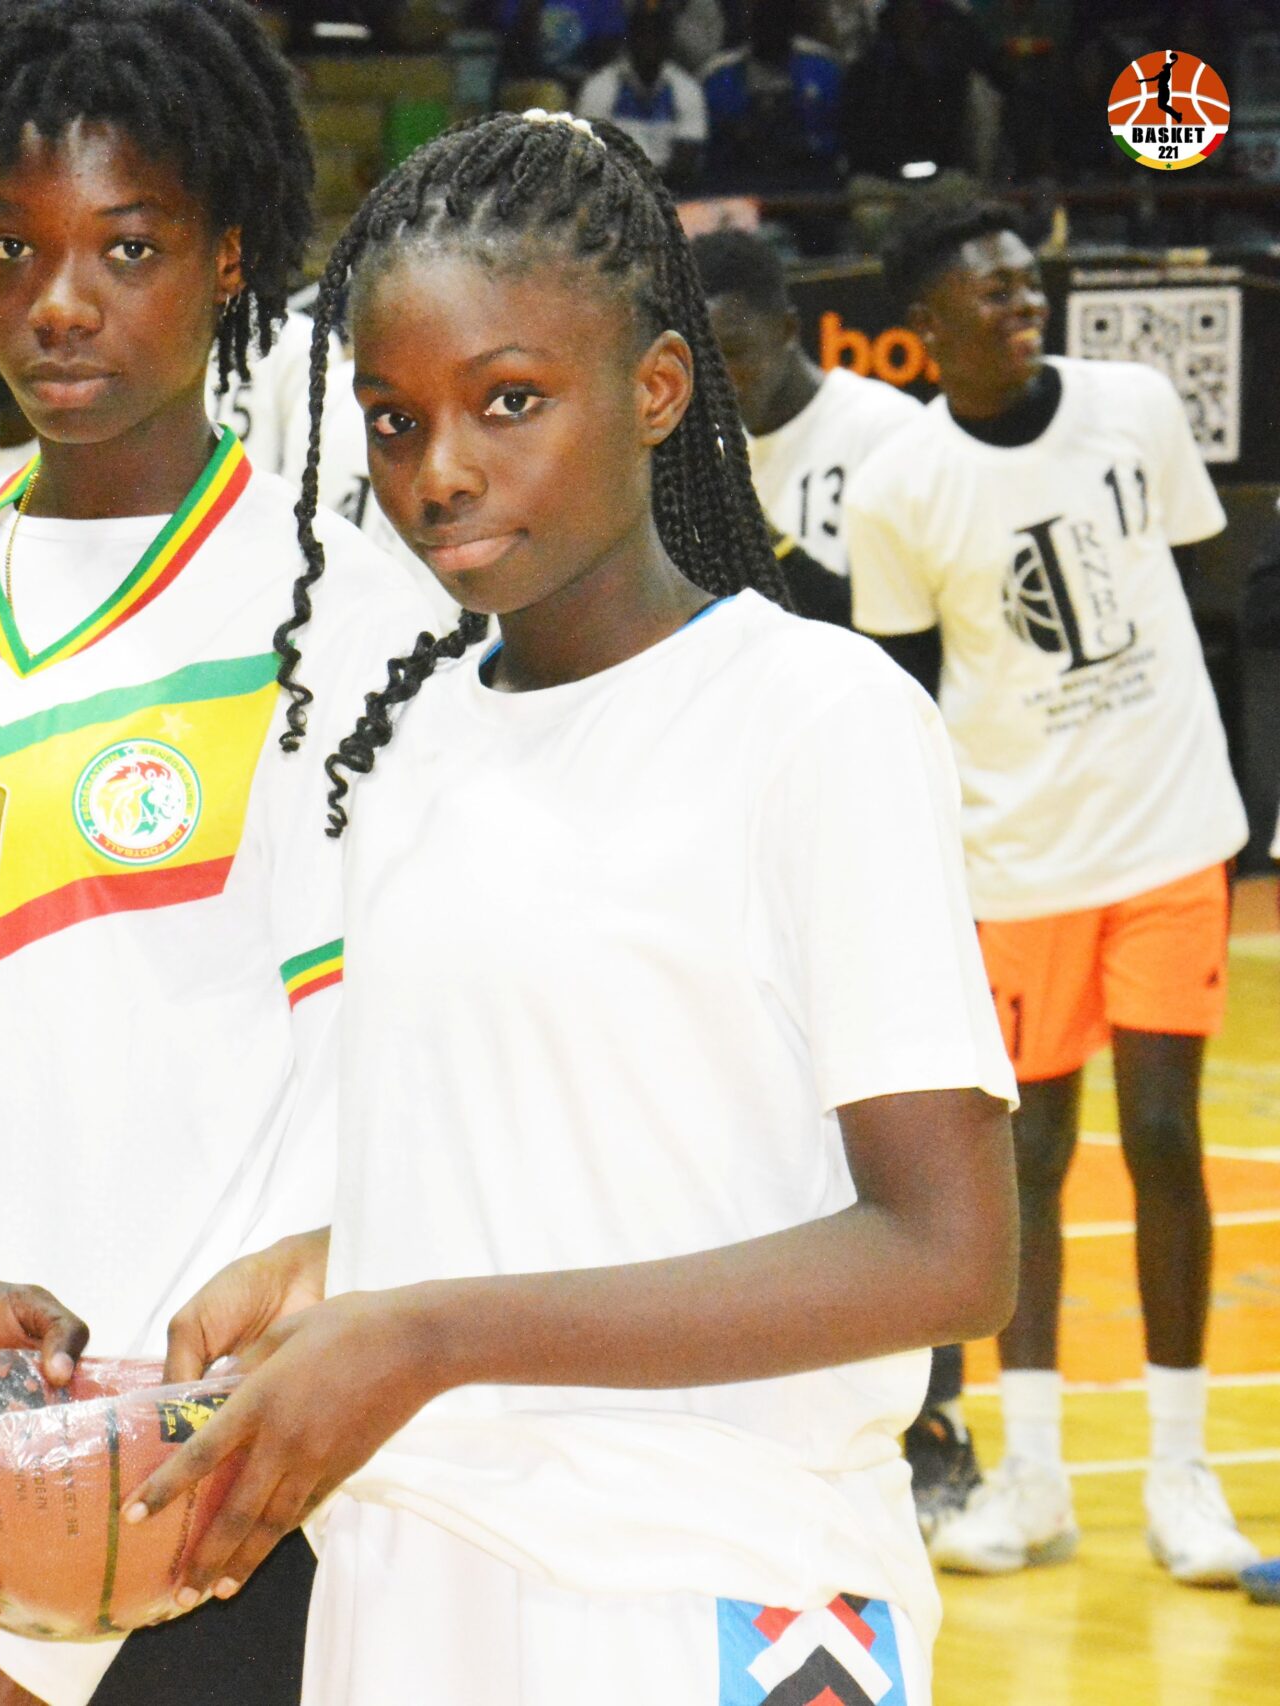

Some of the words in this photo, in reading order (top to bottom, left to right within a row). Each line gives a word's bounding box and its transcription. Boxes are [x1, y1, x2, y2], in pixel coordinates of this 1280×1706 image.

[820, 310, 941, 386] bo
[800, 464, 845, 538] 13
[104, 838, 167, 858] FOOTBALL
[164, 1408, 176, 1436] USA
